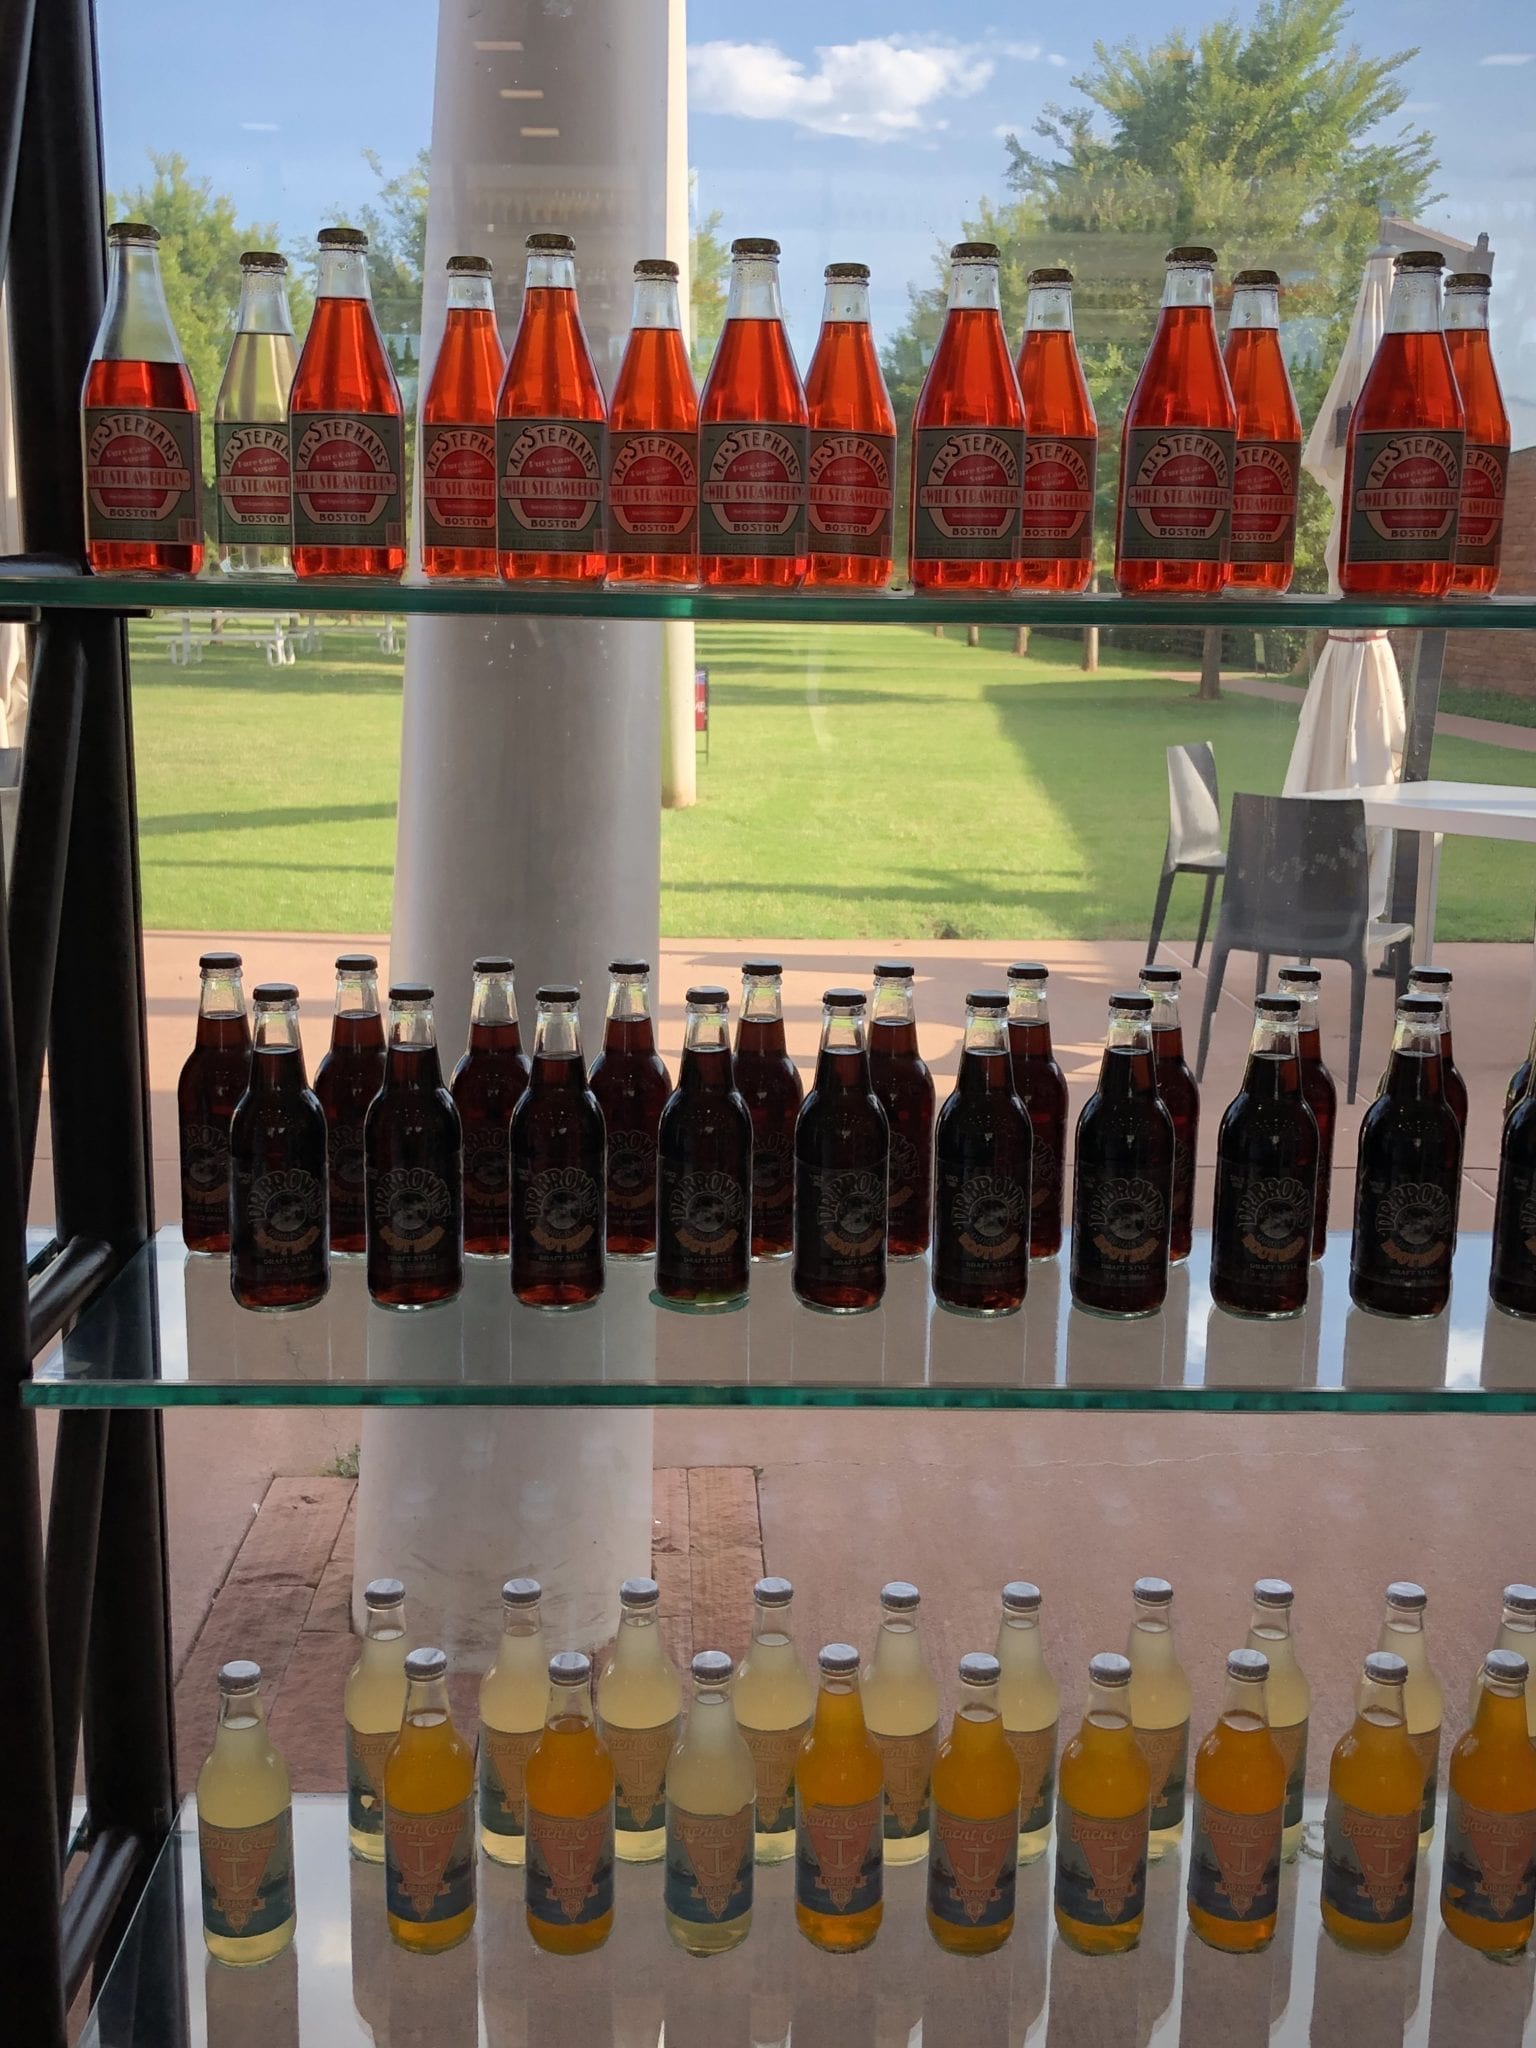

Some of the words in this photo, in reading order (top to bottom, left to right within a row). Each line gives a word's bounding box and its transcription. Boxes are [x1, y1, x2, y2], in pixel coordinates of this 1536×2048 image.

[109, 508, 157, 518] BOSTON
[241, 515, 284, 523] BOSTON
[319, 514, 366, 522] BOSTON
[445, 518, 488, 526] BOSTON
[530, 519, 577, 528] BOSTON
[632, 524, 675, 532] BOSTON
[734, 524, 779, 532] BOSTON
[825, 524, 867, 533] BOSTON
[952, 528, 998, 536] BOSTON
[1160, 528, 1205, 536] BOSTON
[1025, 529, 1067, 537] BOSTON
[1231, 533, 1272, 541] BOSTON
[1391, 529, 1437, 538] BOSTON
